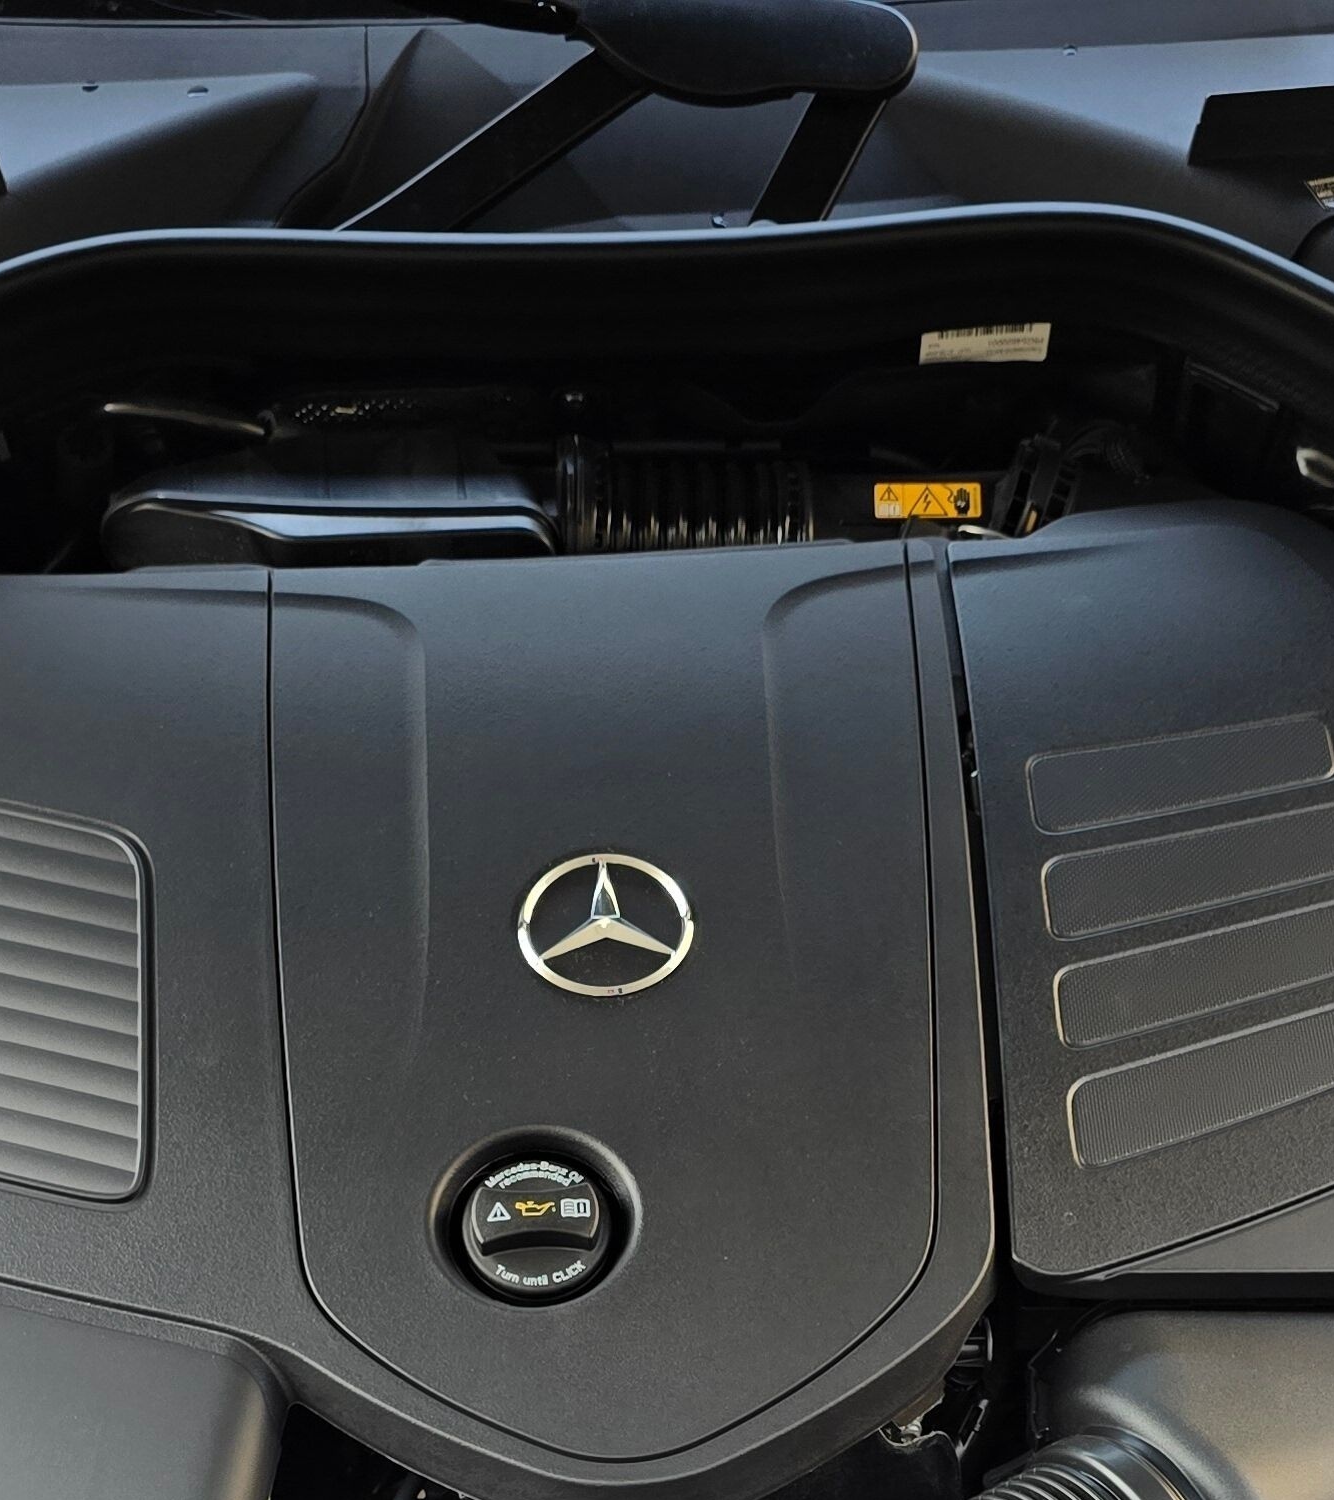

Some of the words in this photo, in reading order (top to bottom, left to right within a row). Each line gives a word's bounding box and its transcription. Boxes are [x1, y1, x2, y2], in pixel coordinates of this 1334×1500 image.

[484, 1161, 569, 1188] Mercedes-Benz
[498, 1170, 572, 1189] recommended
[495, 1264, 520, 1284] Turn
[522, 1274, 549, 1286] until
[552, 1260, 587, 1283] CLICK
